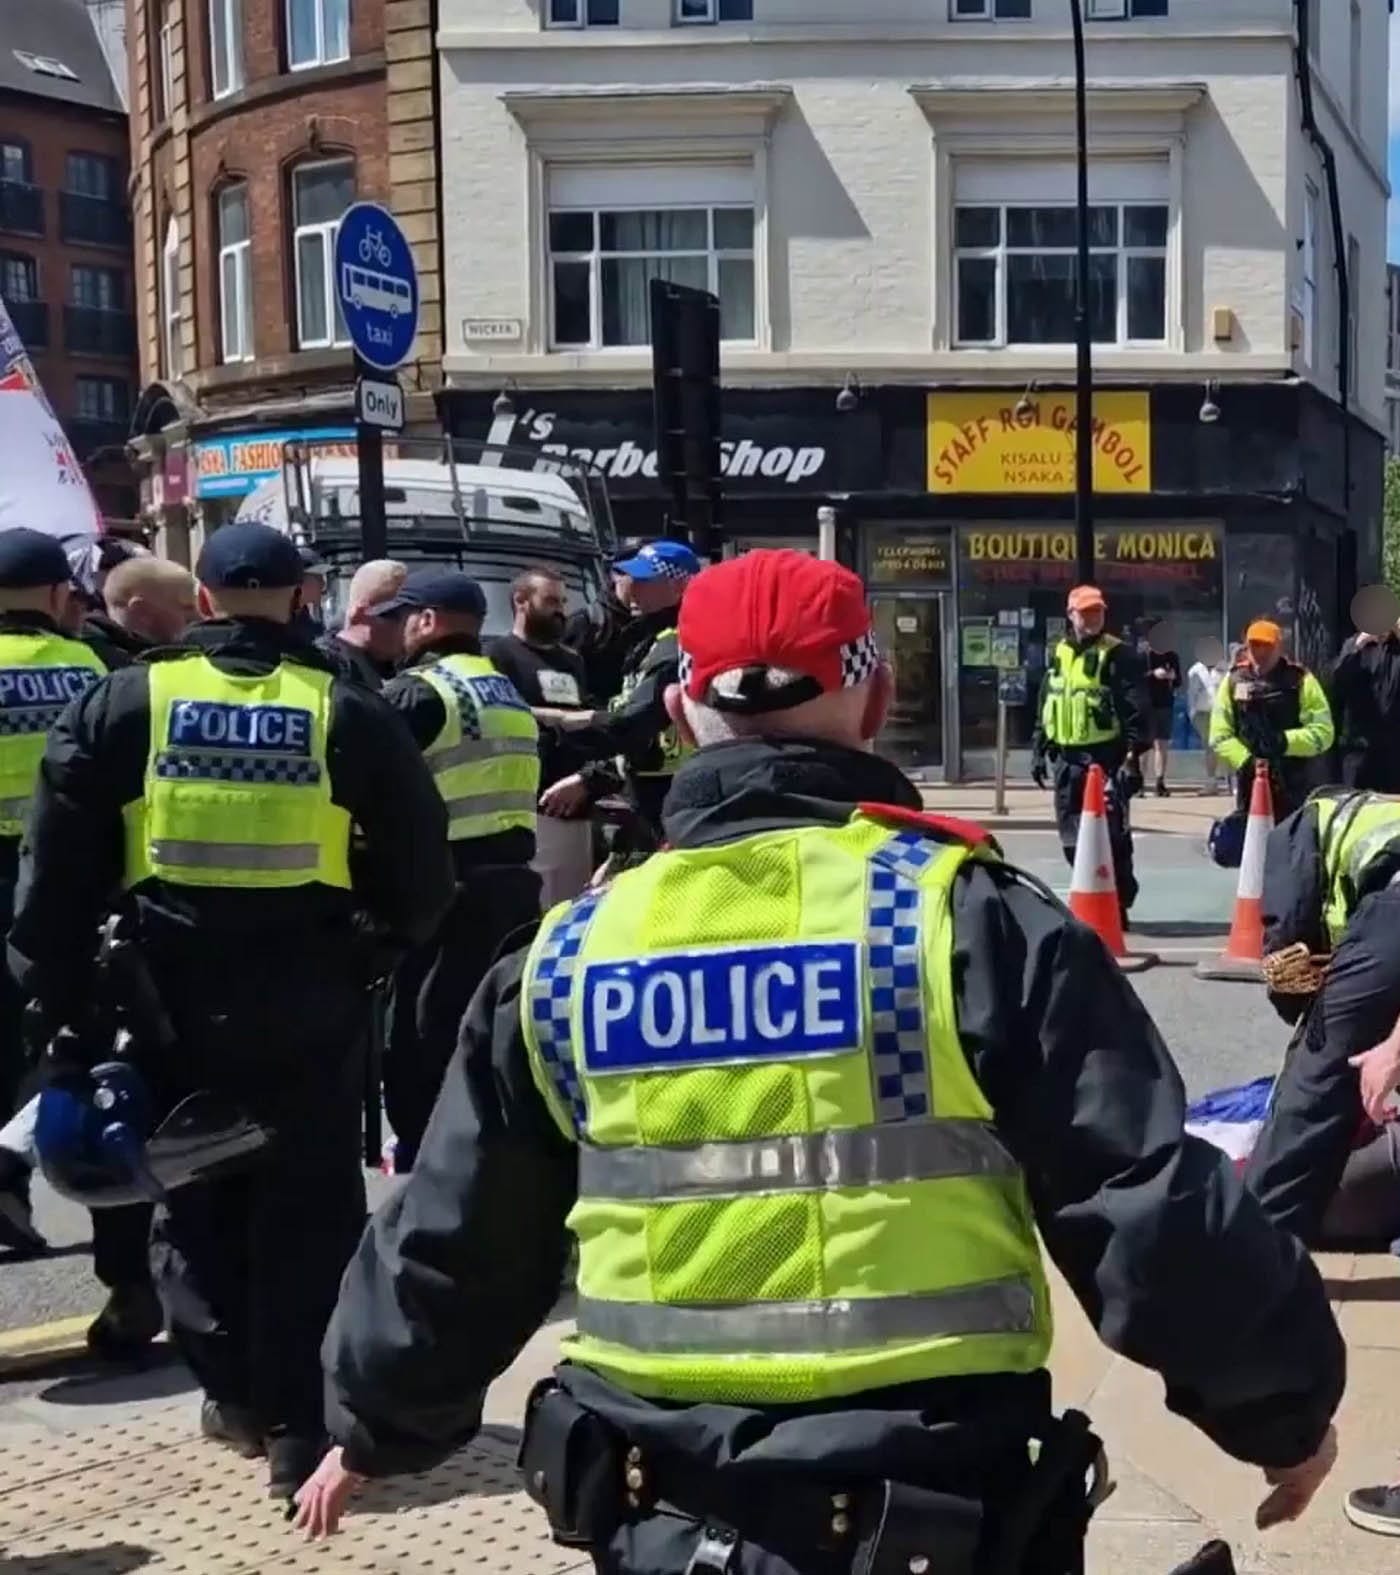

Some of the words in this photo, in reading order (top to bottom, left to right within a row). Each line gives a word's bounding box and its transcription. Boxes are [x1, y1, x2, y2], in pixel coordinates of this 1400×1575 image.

[366, 322, 393, 347] taxi
[469, 324, 513, 336] WICKER
[366, 391, 398, 420] Only
[533, 441, 658, 477] Barbe
[935, 416, 992, 485] STAFF
[1001, 452, 1061, 465] KISALU
[1004, 471, 1064, 483] NSAKA
[1116, 533, 1216, 560] MONICA
[173, 701, 306, 746] POLICE
[592, 960, 845, 1052] POLICE
